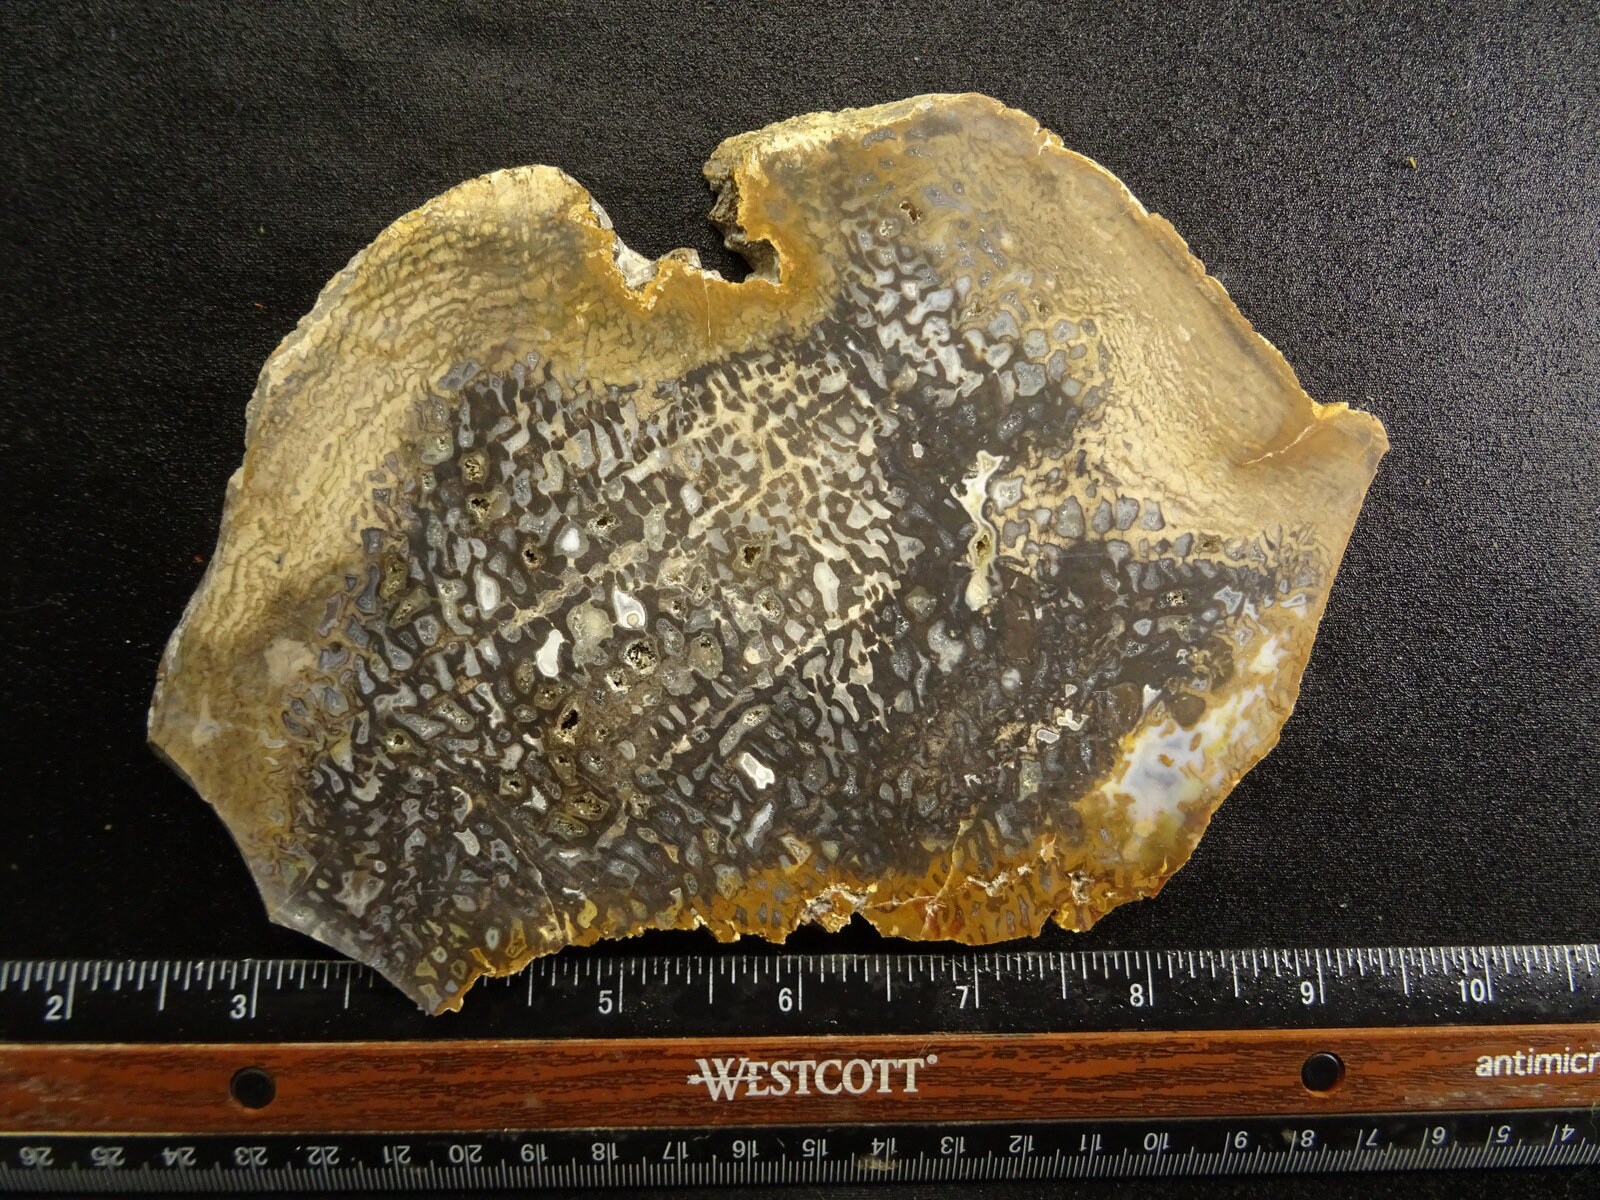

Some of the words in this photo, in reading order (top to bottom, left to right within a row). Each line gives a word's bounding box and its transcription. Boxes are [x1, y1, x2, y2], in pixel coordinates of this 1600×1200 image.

[45, 996, 64, 1020] 2
[230, 995, 247, 1019] 3
[598, 990, 613, 1014] 5
[778, 988, 793, 1012] 6
[956, 987, 970, 1009] 7
[1129, 983, 1144, 1007] 8
[1300, 981, 1315, 1005] 9
[1458, 978, 1485, 1002] 10
[1475, 1046, 1600, 1077] antimicr
[1080, 1133, 1103, 1152] 11
[1143, 1132, 1170, 1151] 10
[1234, 1130, 1248, 1149] 9
[1301, 1129, 1315, 1147] 8
[1365, 1128, 1379, 1146] 7
[1431, 1126, 1446, 1145] 6
[1496, 1125, 1511, 1143] 5
[1561, 1123, 1575, 1142] 4
[382, 1144, 411, 1164] 21
[449, 1143, 483, 1164] 20
[520, 1143, 548, 1164] 19
[592, 1142, 619, 1162] 18
[663, 1141, 689, 1160] 17
[732, 1139, 760, 1159] 16
[802, 1138, 829, 1158] 15
[871, 1137, 898, 1156] 14
[940, 1136, 966, 1155] 13
[1009, 1135, 1034, 1153] 12
[19, 1145, 54, 1166] 26
[91, 1145, 125, 1166] 25
[162, 1145, 196, 1166] 24
[234, 1145, 268, 1166] 23
[307, 1145, 340, 1165] 22
